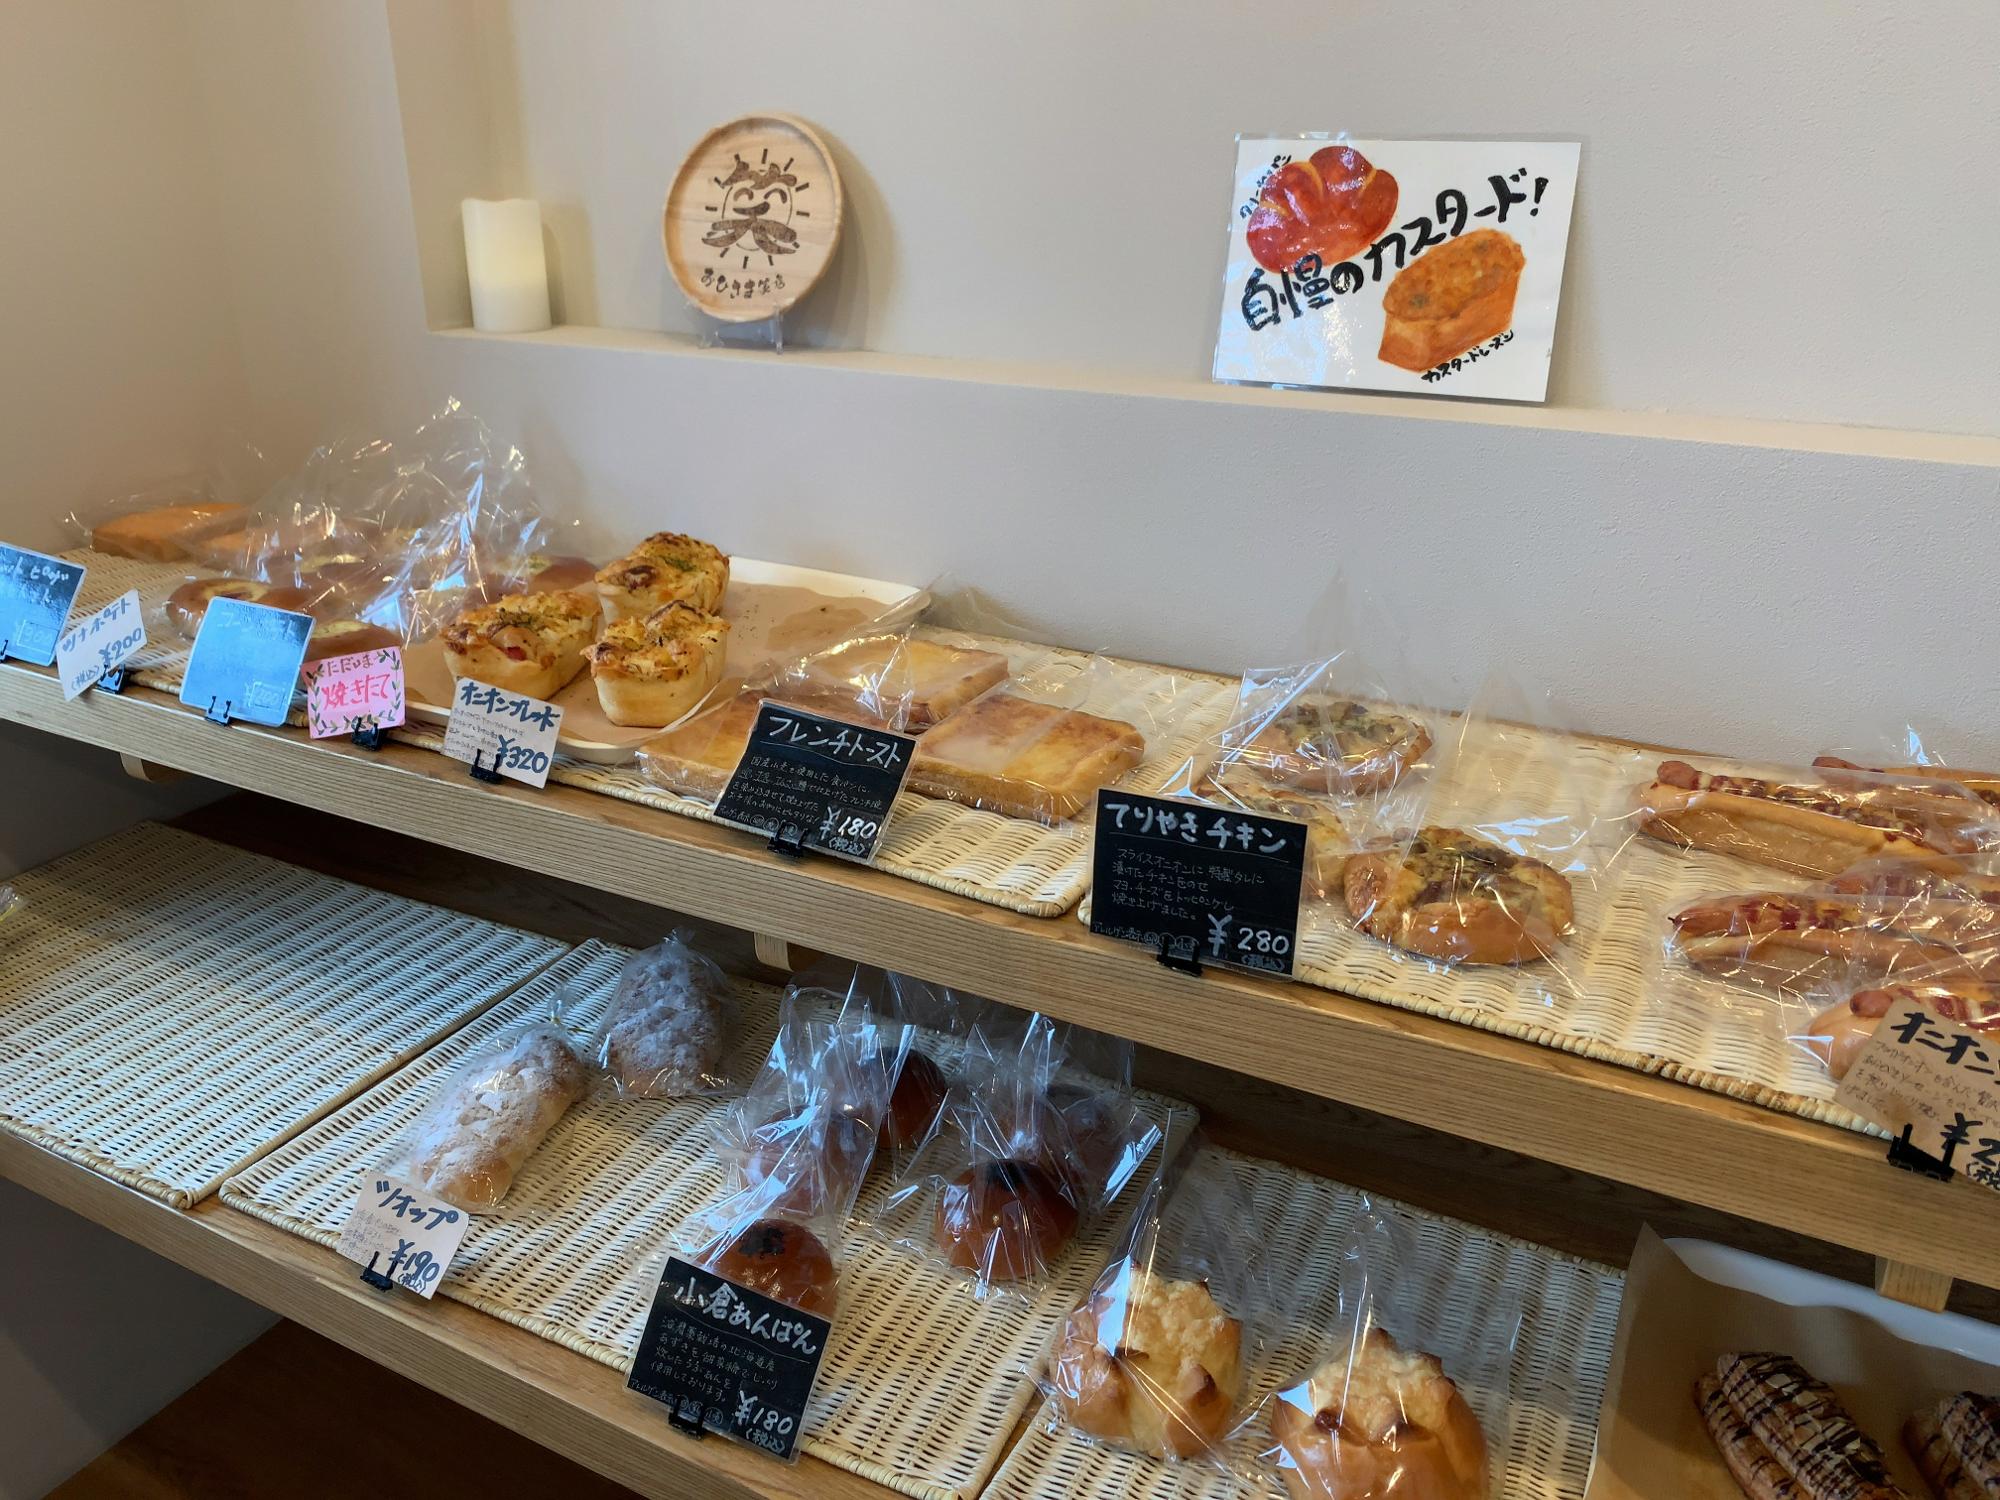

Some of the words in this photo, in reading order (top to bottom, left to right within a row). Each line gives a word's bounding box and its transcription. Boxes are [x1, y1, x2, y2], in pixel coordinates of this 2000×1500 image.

[1421, 330, 1514, 383] カスタードレーズン
[62, 598, 131, 652] ツナポテト
[100, 627, 142, 667] ¥200
[327, 655, 374, 677] ただいま
[321, 673, 391, 711] 焼きたて
[498, 735, 550, 774] ¥320
[769, 716, 901, 768] フレンチトースト
[819, 806, 877, 841] ¥180
[828, 836, 867, 856] (税込)
[1891, 1012, 2000, 1085] オニオン
[388, 1238, 441, 1283] ¥190
[673, 1276, 817, 1356] 小倉あんぱん
[734, 1389, 794, 1436] ¥180
[745, 1427, 787, 1455] (税込)
